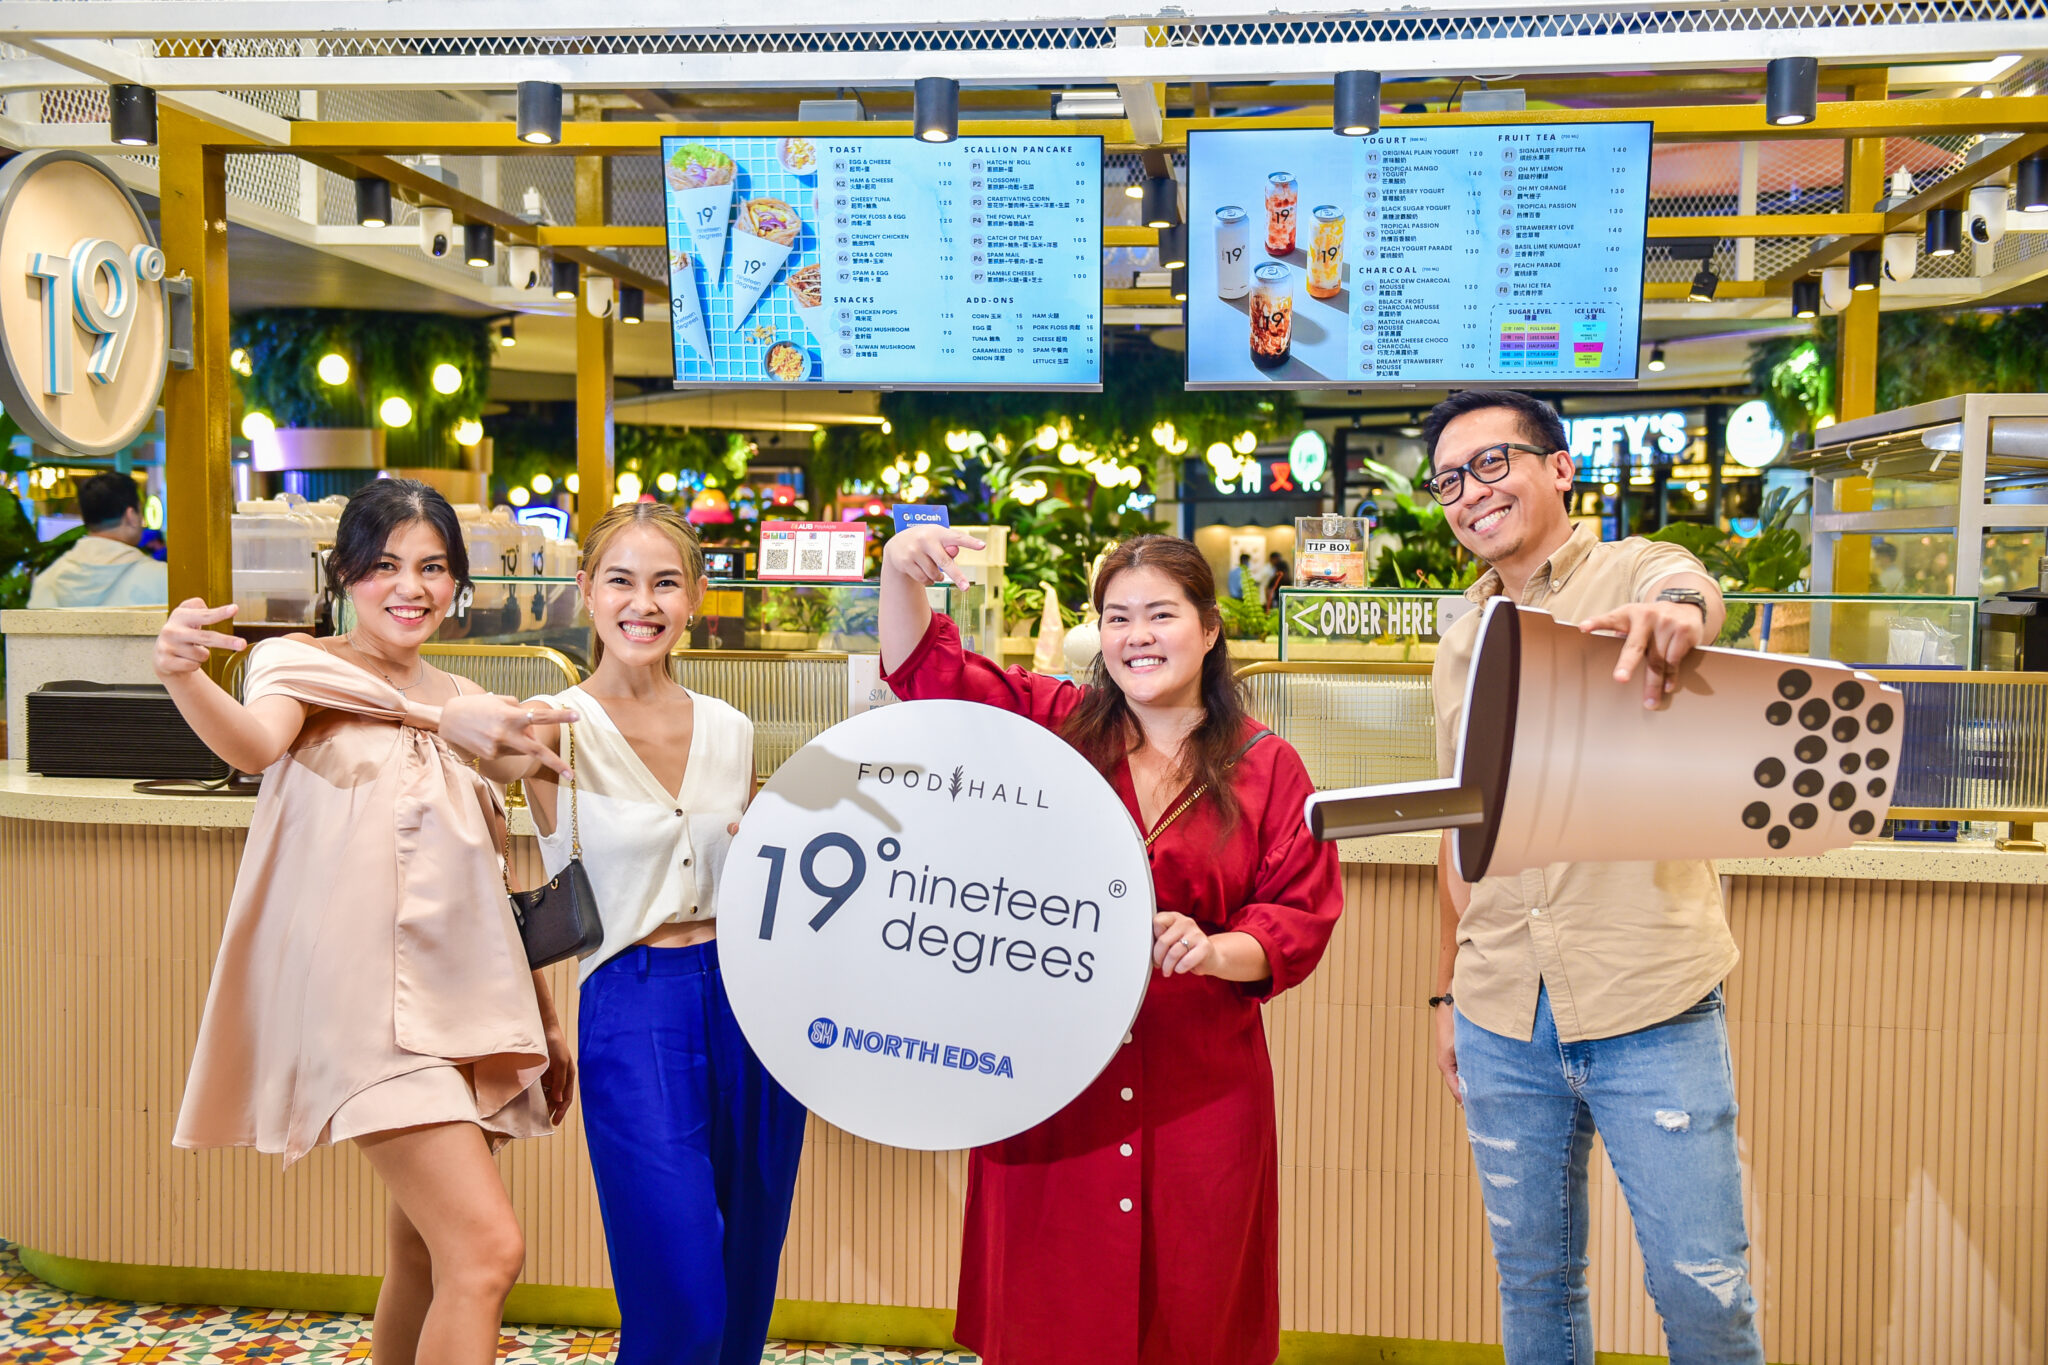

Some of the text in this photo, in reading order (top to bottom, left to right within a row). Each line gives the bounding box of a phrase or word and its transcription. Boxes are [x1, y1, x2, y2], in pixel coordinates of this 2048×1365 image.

[1308, 542, 1350, 552] TIP BOX
[1320, 602, 1433, 635] ORDER HERE
[857, 761, 1049, 809] FOOD HALL
[888, 865, 1101, 933] nineteen
[881, 911, 1096, 984] degrees
[842, 1026, 940, 1065] NORTH
[942, 1045, 1015, 1079] EDSA
